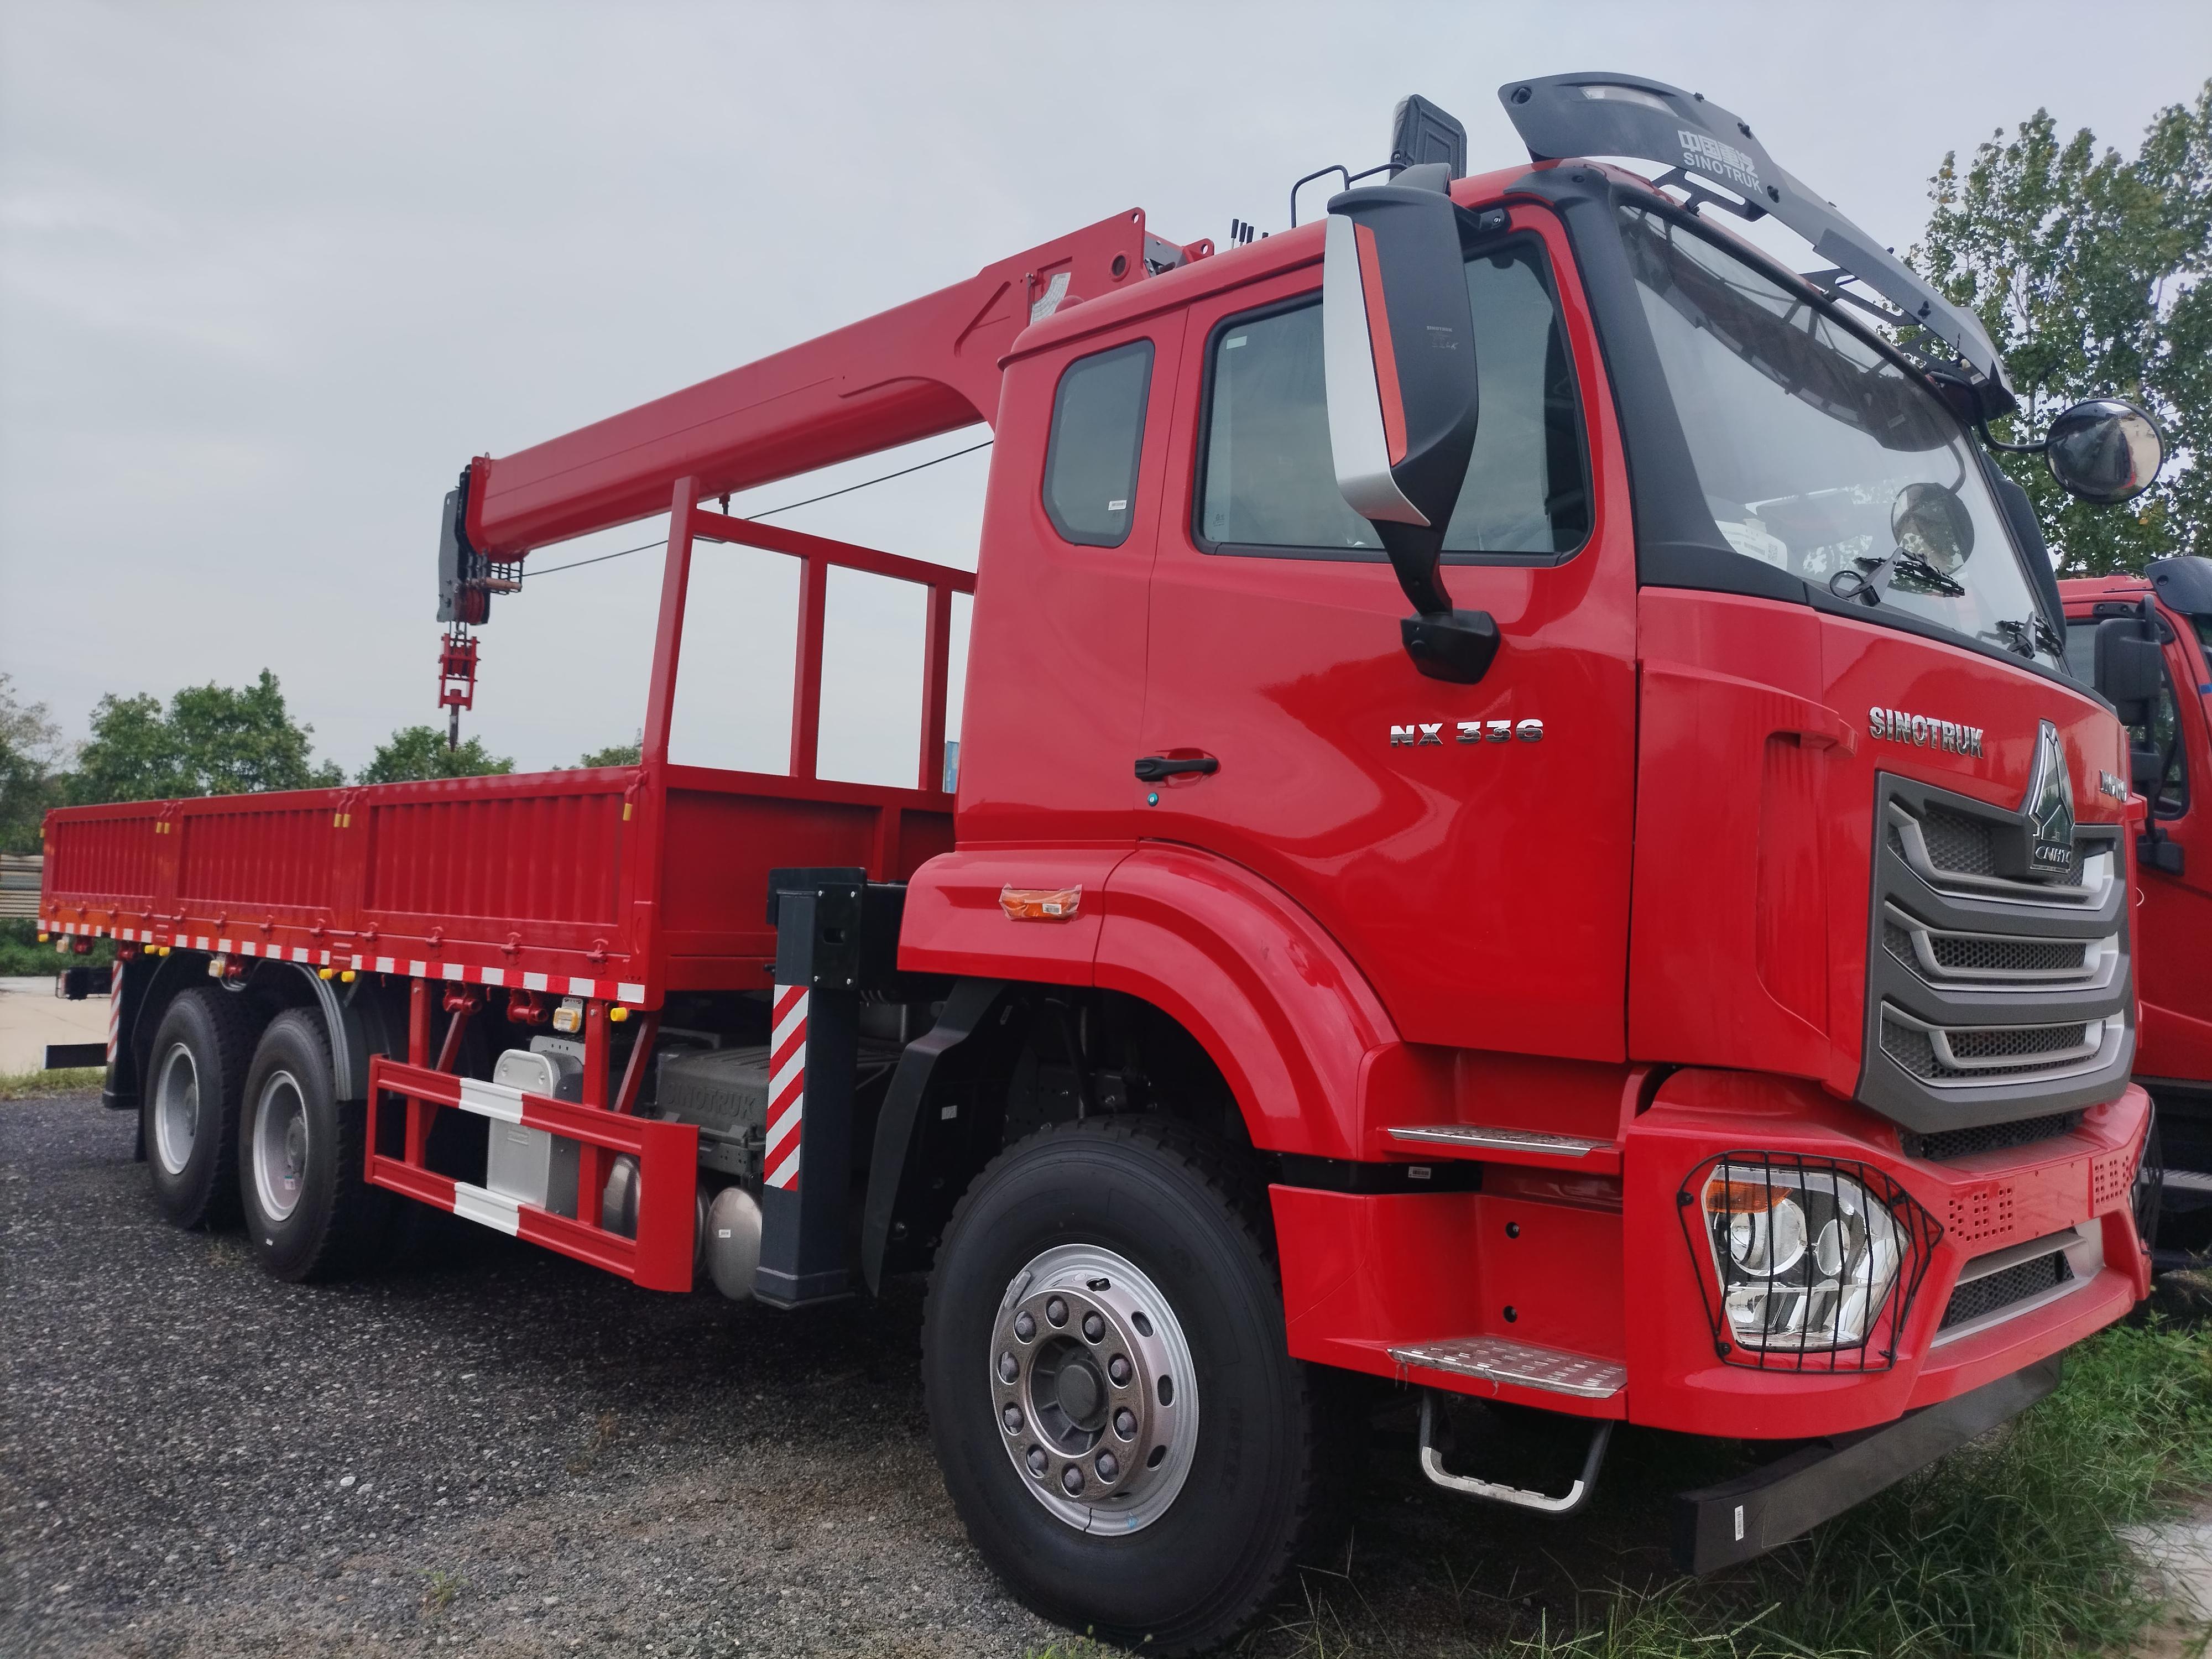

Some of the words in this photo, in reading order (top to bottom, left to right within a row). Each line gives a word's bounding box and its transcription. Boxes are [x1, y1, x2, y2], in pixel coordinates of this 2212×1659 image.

[1677, 130, 1759, 179] 中国重汽
[1683, 152, 1763, 194] SINOTRUK
[1390, 723, 1443, 747] NX
[1455, 719, 1543, 743] 336
[1869, 706, 1984, 759] SINOTRUK
[667, 1082, 757, 1121] SINOTRUK
